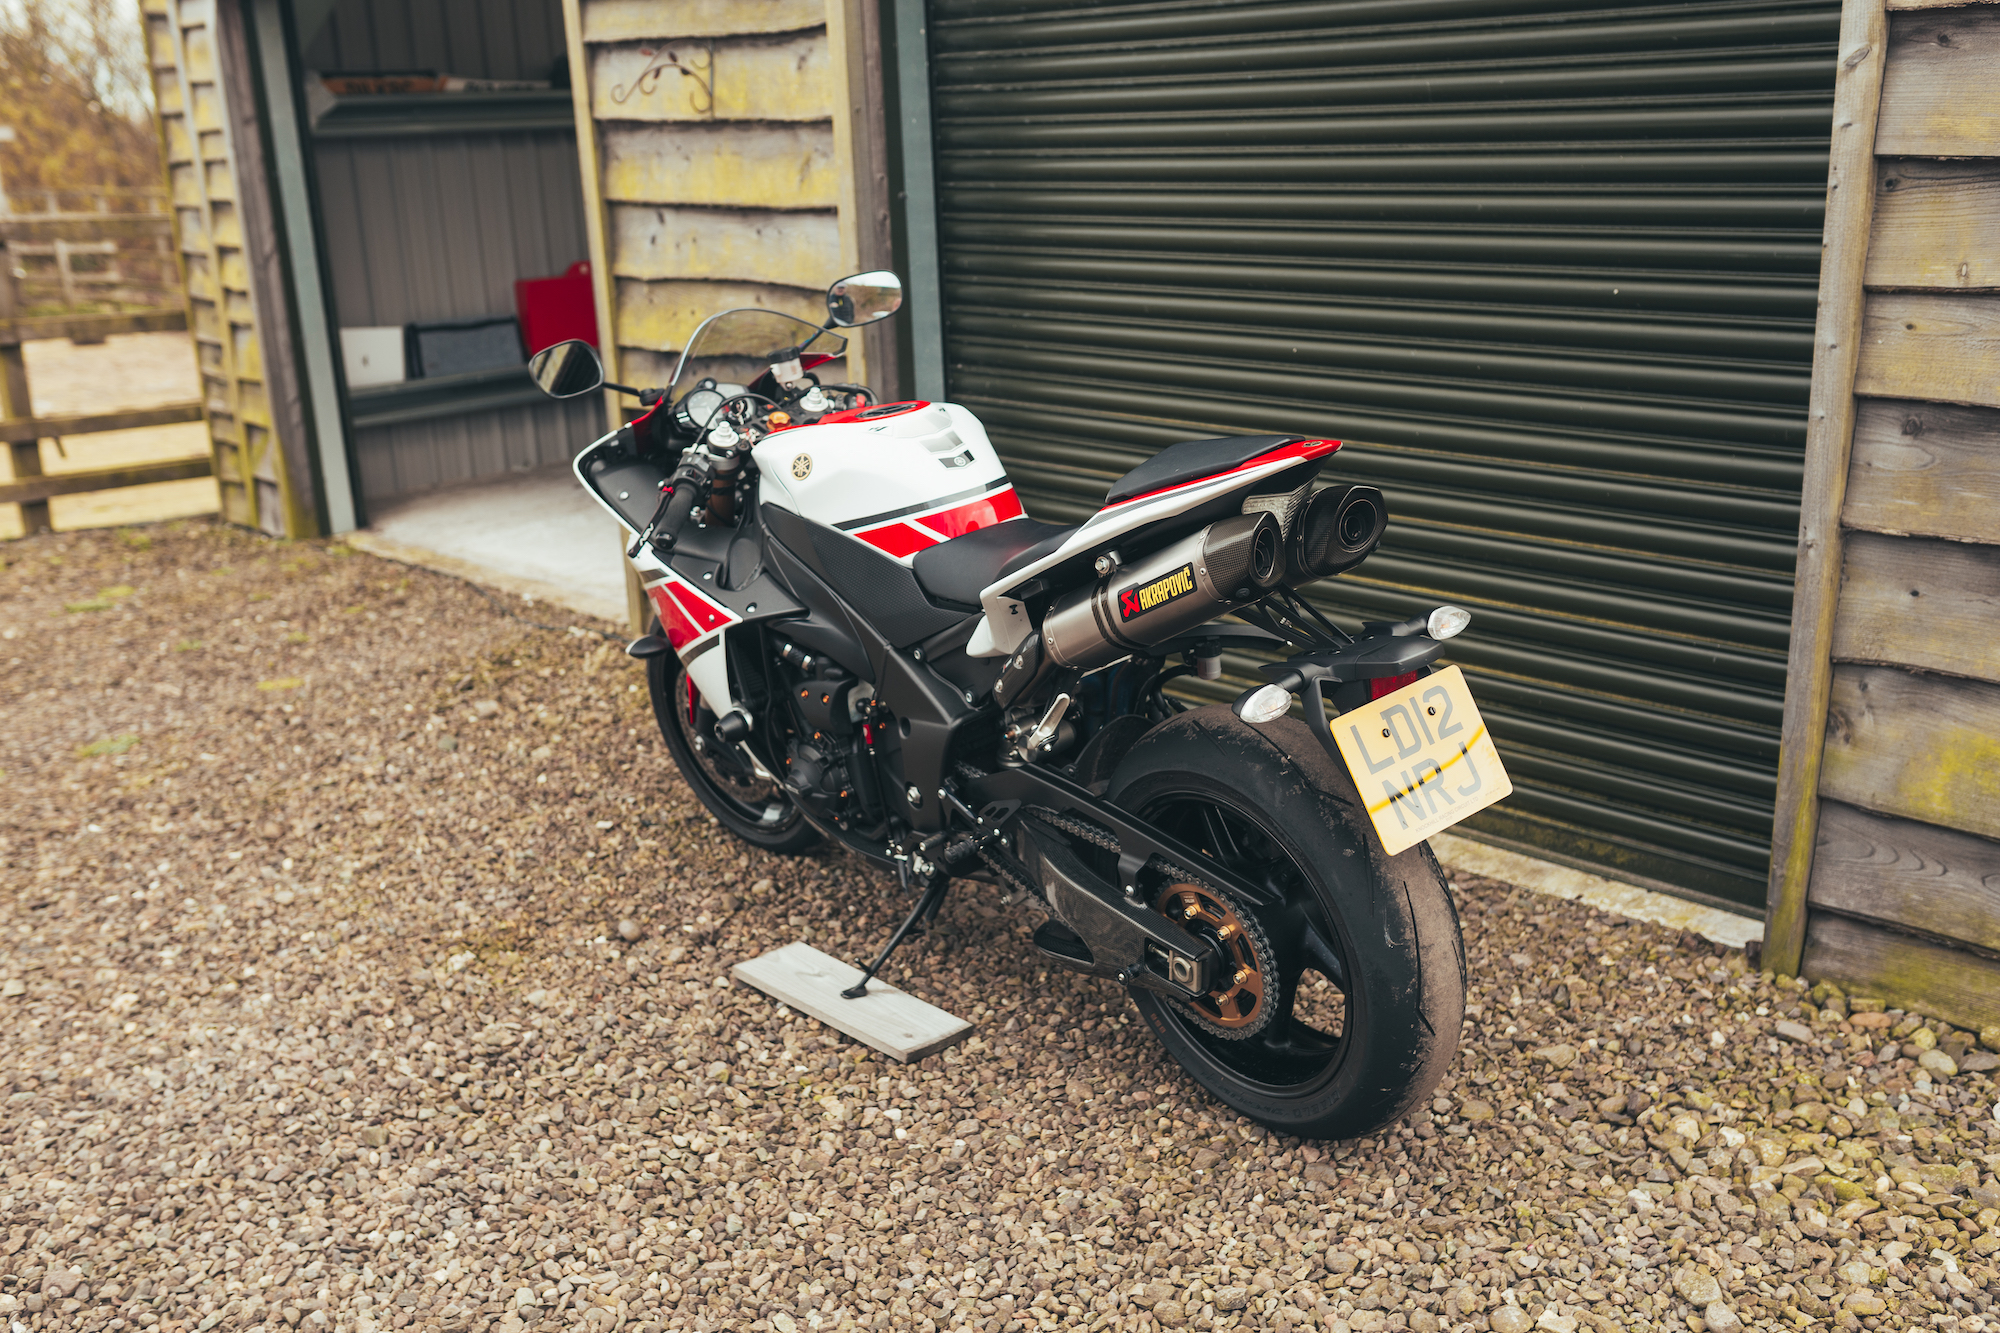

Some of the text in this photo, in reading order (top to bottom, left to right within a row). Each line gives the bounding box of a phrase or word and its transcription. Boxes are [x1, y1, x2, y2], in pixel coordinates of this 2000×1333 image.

[1139, 566, 1194, 610] AKRAPOVIČ
[1350, 685, 1463, 775] LD12
[1382, 741, 1482, 830] NRJ
[1415, 818, 1439, 832] KNOCKHILL
[1439, 809, 1455, 821] RACING
[1454, 800, 1471, 812] CIRCUIT
[1470, 796, 1479, 804] LTD
[1292, 1089, 1341, 1118] DIABLO
